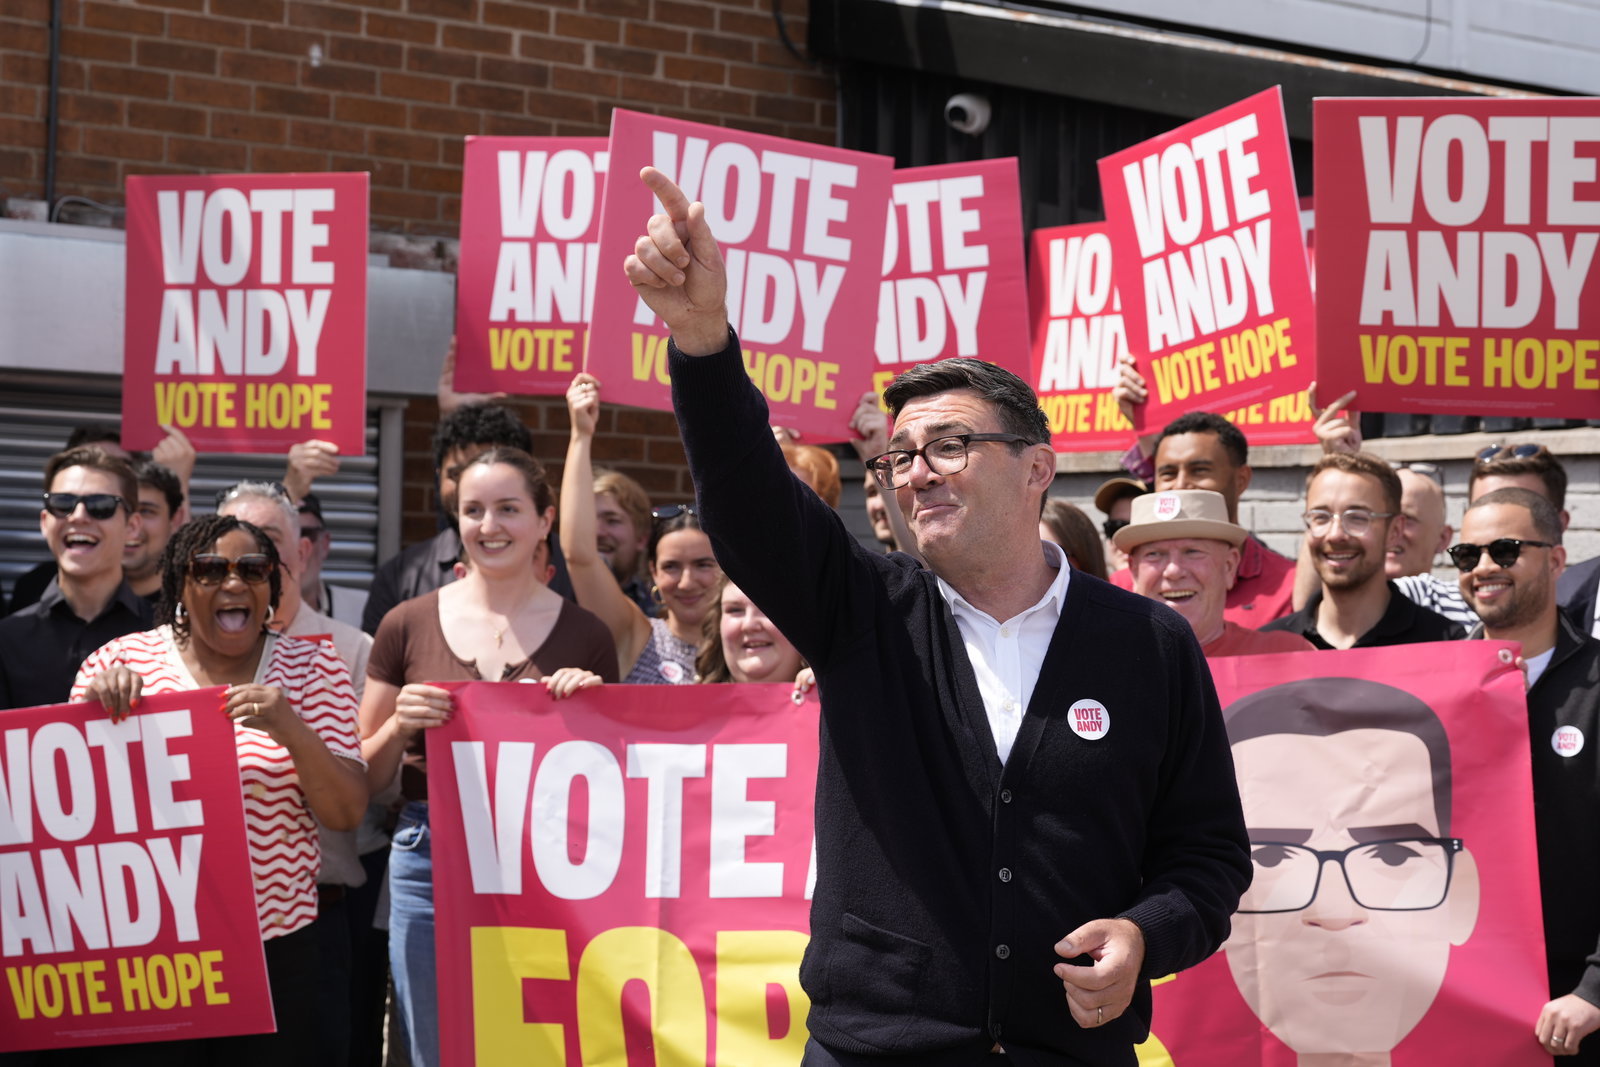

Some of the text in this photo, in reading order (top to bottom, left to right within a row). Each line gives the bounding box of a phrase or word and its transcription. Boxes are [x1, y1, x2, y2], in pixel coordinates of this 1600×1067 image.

[497, 149, 610, 240] VO
[653, 131, 858, 261] VOTE
[1122, 112, 1271, 259] VOTE
[1358, 114, 1600, 227] VOTE
[157, 188, 335, 286] VOTE
[881, 175, 989, 277] TE
[489, 241, 600, 323] AN
[874, 271, 987, 365] DY
[1049, 233, 1121, 318] VO
[1142, 218, 1274, 352] ANDY
[1359, 229, 1600, 330] ANDY
[154, 289, 332, 376] ANDY
[488, 328, 574, 372] VOTE
[1039, 314, 1131, 392] AND
[1151, 341, 1222, 405] VOTE
[1220, 317, 1297, 385] HOPE
[1359, 334, 1600, 390] VOTE HOPE
[154, 382, 332, 429] VOTE HOPE
[742, 349, 840, 410] HOPE
[1074, 707, 1102, 720] VOTE
[1077, 720, 1102, 732] ANDY
[0, 709, 204, 846] VOTE
[451, 740, 788, 900] VOTE
[0, 834, 203, 957] ANDY
[6, 950, 230, 1020] VOTE HOPE
